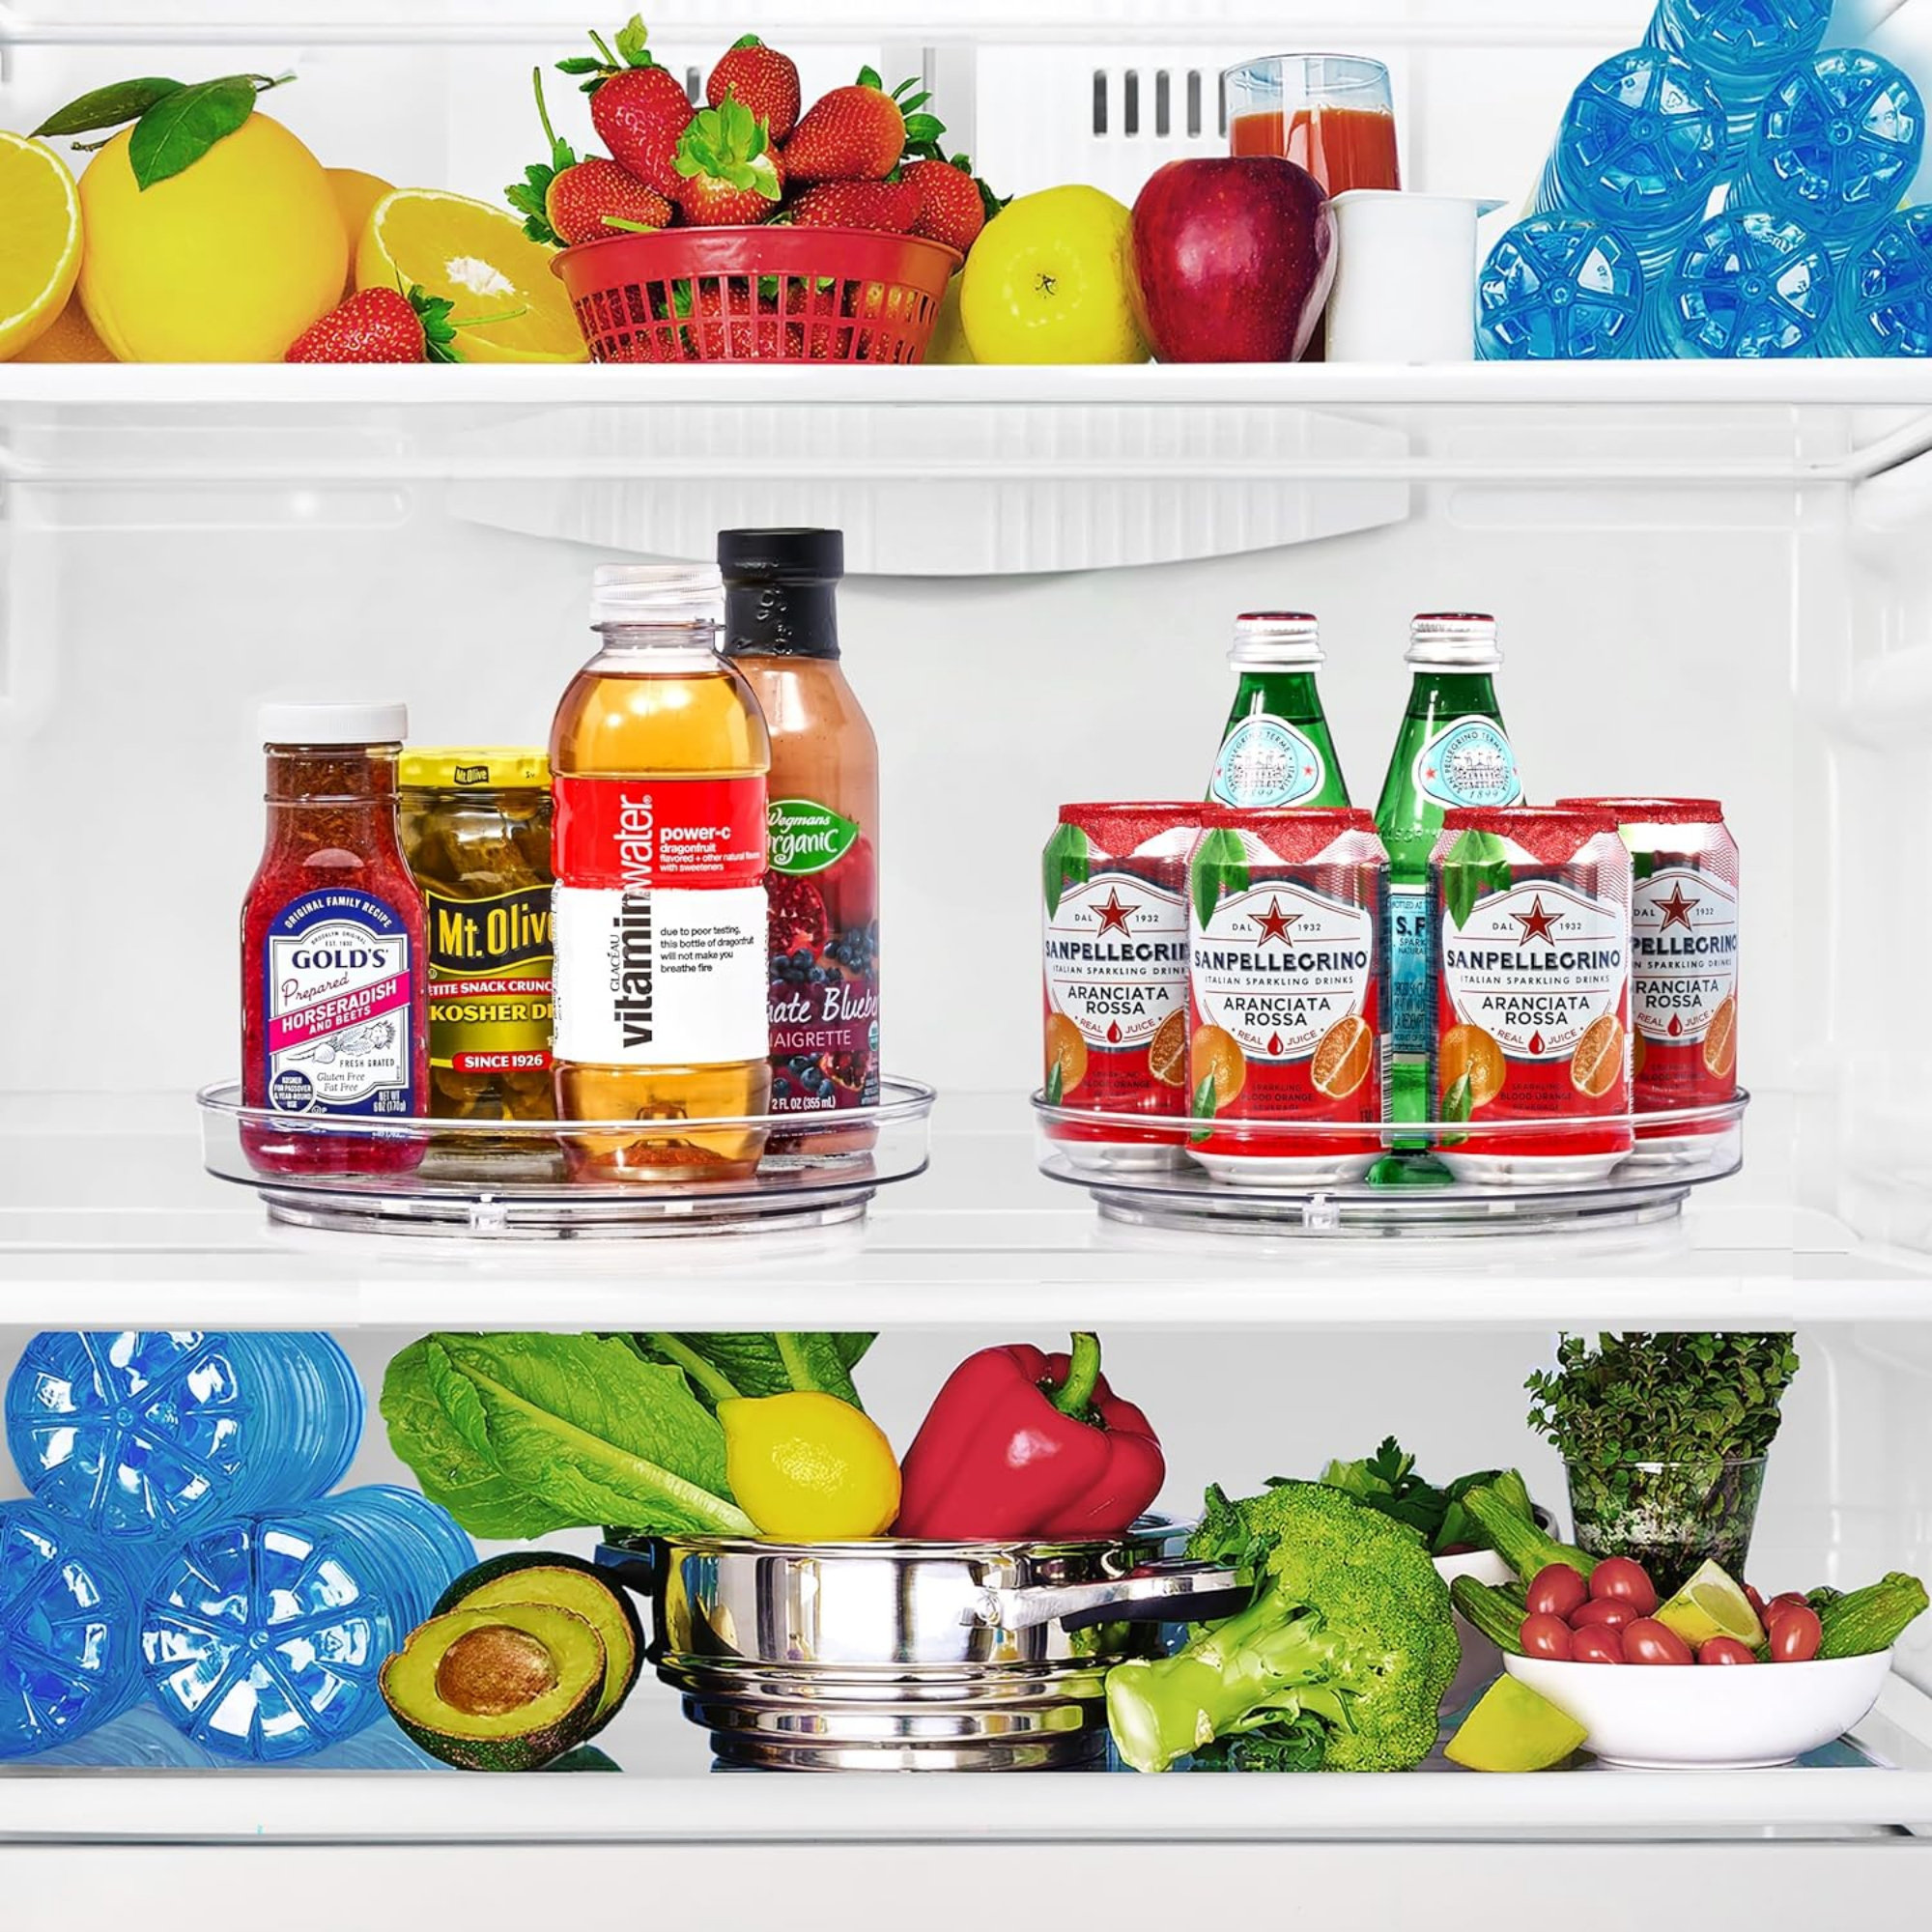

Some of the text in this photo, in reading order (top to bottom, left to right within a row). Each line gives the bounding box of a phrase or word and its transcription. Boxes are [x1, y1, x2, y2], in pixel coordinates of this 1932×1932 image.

[1444, 731, 1479, 773] PELLEGRINO
[467, 768, 488, 782] Olive
[659, 826, 731, 843] power-c
[660, 842, 717, 854] dragonfruit
[660, 854, 694, 863] flavored
[702, 853, 723, 862] other
[660, 864, 677, 872] with
[284, 895, 392, 928] ORIGINAL FAMILY RECIPE
[439, 908, 482, 957] Mt.
[660, 927, 678, 936] due
[679, 927, 690, 936] to
[691, 928, 712, 937] poor
[1232, 923, 1321, 931] DAL 1932
[1492, 923, 1515, 931] DAL
[679, 939, 706, 948] bottle
[292, 949, 387, 969] GOLD'S
[678, 952, 693, 960] not
[695, 951, 718, 959] make
[719, 951, 734, 960] you
[1194, 951, 1367, 972] SANPELLEGRINO
[1447, 950, 1621, 971] SANPELLEGRINO
[660, 963, 713, 973] breathe fire
[1053, 965, 1082, 974] ITALIAN
[1647, 959, 1704, 969] SPARKLING
[460, 980, 507, 994] SNACK
[1205, 976, 1353, 986] ITALIAN SPARKLING DRINKS
[1460, 975, 1610, 985] ITALIAN SPARKLING DRINKS
[1634, 979, 1719, 994] RANCIATA
[281, 971, 350, 1007] Prepared
[1067, 985, 1170, 1000] ARANCIATA
[282, 979, 397, 1034] HORSERADISH
[1086, 1001, 1146, 1014] ROSSA
[1223, 997, 1331, 1011] ARANCIATA
[1482, 996, 1590, 1010] ARANCIATA
[1645, 994, 1702, 1009] ROSSA
[309, 1005, 372, 1035] AND BEETS
[429, 1005, 527, 1022] KOSHER
[1244, 1013, 1308, 1026] ROSSA
[1505, 1011, 1568, 1025] ROSSA
[1637, 1010, 1710, 1027] REAL JUICE
[1079, 1018, 1156, 1034] REAL JUICE
[770, 1030, 852, 1047] AIGRETTE
[1236, 1029, 1318, 1046] REAL JUICE
[1497, 1028, 1577, 1044] REAL JUICE
[339, 1058, 395, 1067] FRESH GRATED
[465, 1055, 543, 1068] SINCE 1926
[317, 1072, 365, 1082] Gluten Free
[324, 1083, 358, 1093] Fat Free
[779, 1098, 788, 1109] FL
[790, 1098, 802, 1109] OZ
[803, 1097, 820, 1110] (355
[821, 1095, 837, 1109] mL)
